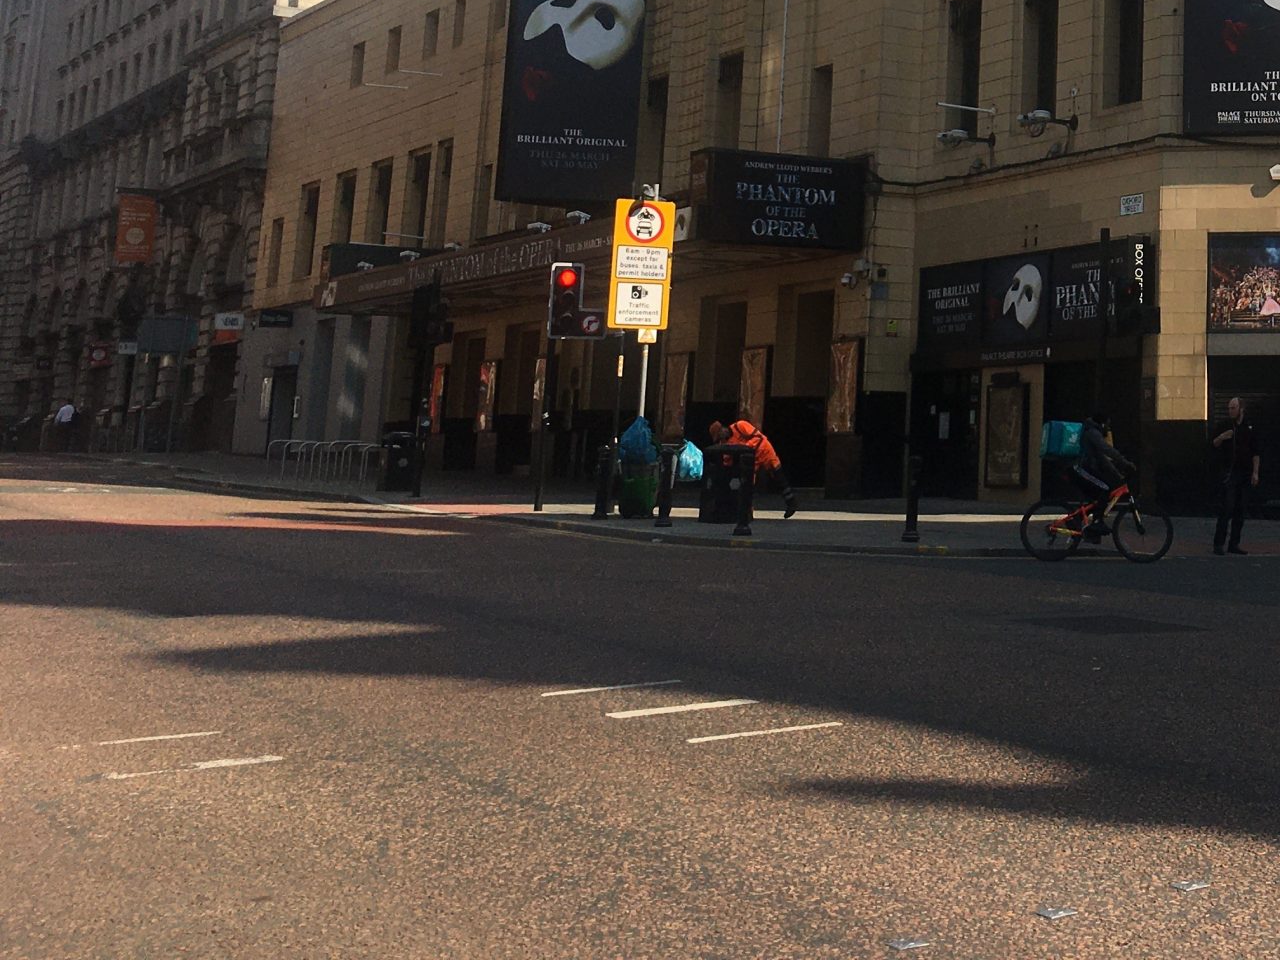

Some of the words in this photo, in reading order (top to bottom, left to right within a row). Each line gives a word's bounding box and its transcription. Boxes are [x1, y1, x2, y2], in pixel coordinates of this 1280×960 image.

[1210, 81, 1277, 93] BRILLIANT
[1251, 93, 1267, 102] ON
[517, 134, 576, 146] BRILLIANT
[576, 137, 628, 148] ORIGINAL
[744, 161, 775, 169] ANDREW
[776, 163, 800, 172] LLOYD
[776, 173, 800, 184] THE
[736, 182, 836, 206] PHANTOM
[766, 205, 780, 216] OF
[783, 206, 806, 218] THE
[752, 218, 819, 240] OPERA
[1134, 243, 1144, 266] BOX
[618, 269, 639, 277] permit
[640, 270, 664, 278] holders
[1086, 268, 1100, 282] TH
[928, 288, 942, 299] THE
[935, 296, 970, 310] ORIGINAL
[1062, 307, 1074, 320] OF
[1078, 303, 1097, 319] THE
